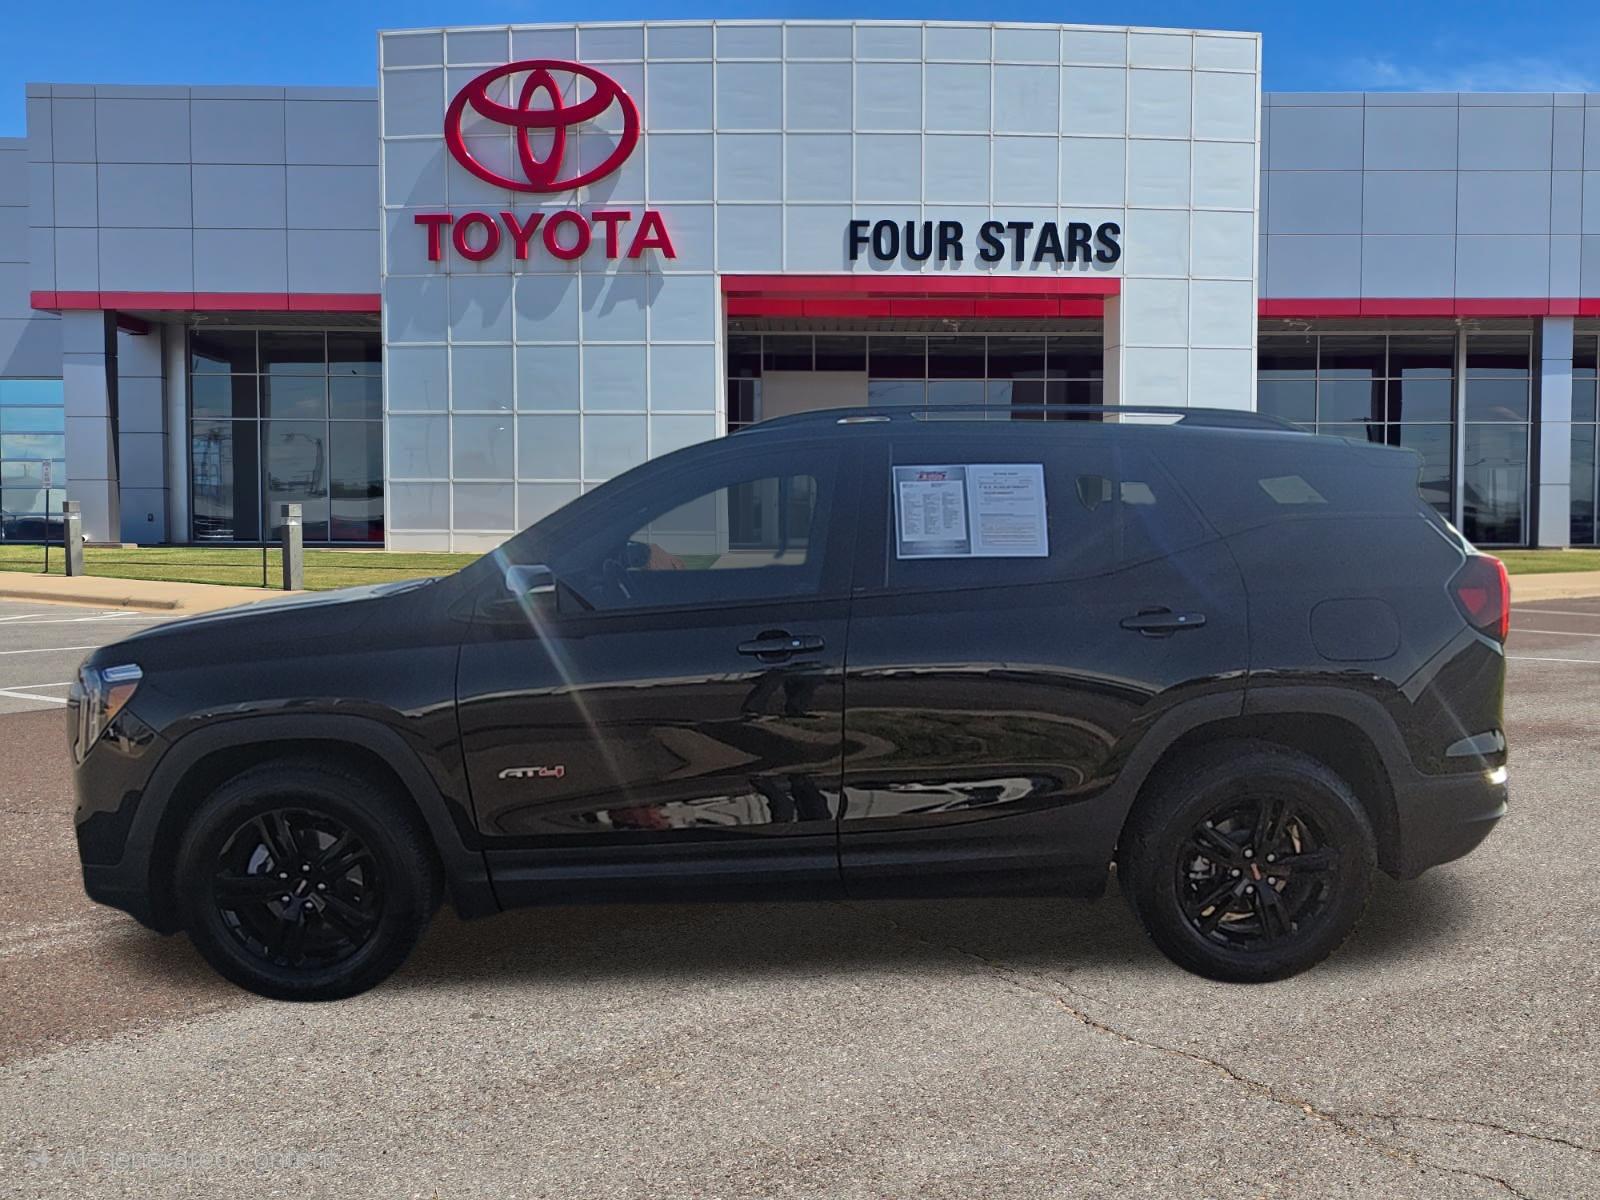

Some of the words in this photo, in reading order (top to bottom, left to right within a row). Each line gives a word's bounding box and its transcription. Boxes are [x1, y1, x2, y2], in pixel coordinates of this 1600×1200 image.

[414, 210, 677, 262] TOYOTA
[849, 219, 964, 262] FOUR
[979, 220, 1122, 264] STARS
[498, 765, 565, 779] AT4
